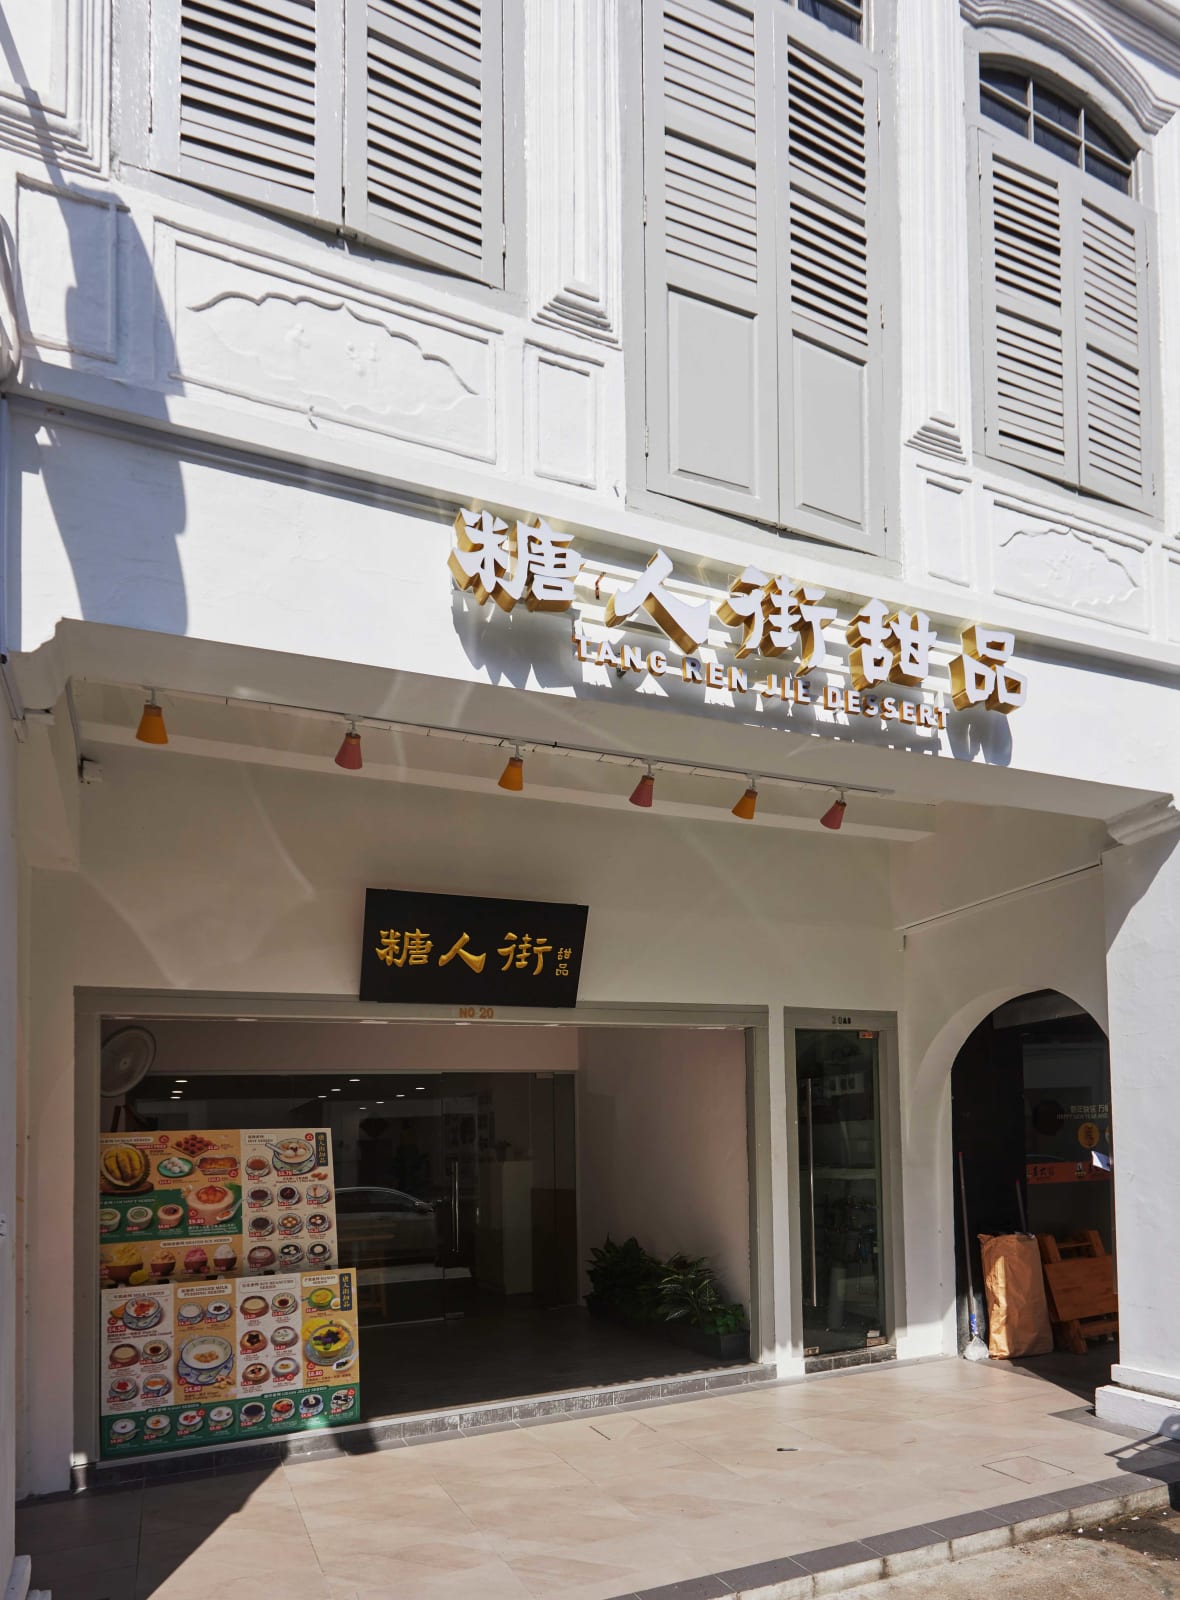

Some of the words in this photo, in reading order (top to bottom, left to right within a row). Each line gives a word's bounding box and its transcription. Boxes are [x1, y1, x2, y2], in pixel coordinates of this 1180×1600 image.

[449, 507, 1028, 714] 糖人街甜品
[572, 634, 667, 677] TANG
[682, 655, 749, 694] REN
[762, 673, 813, 705] JIE
[823, 685, 950, 730] DESSERT
[375, 928, 553, 976] 糖人街
[459, 1007, 475, 1019] NO
[479, 1008, 494, 1020] 20
